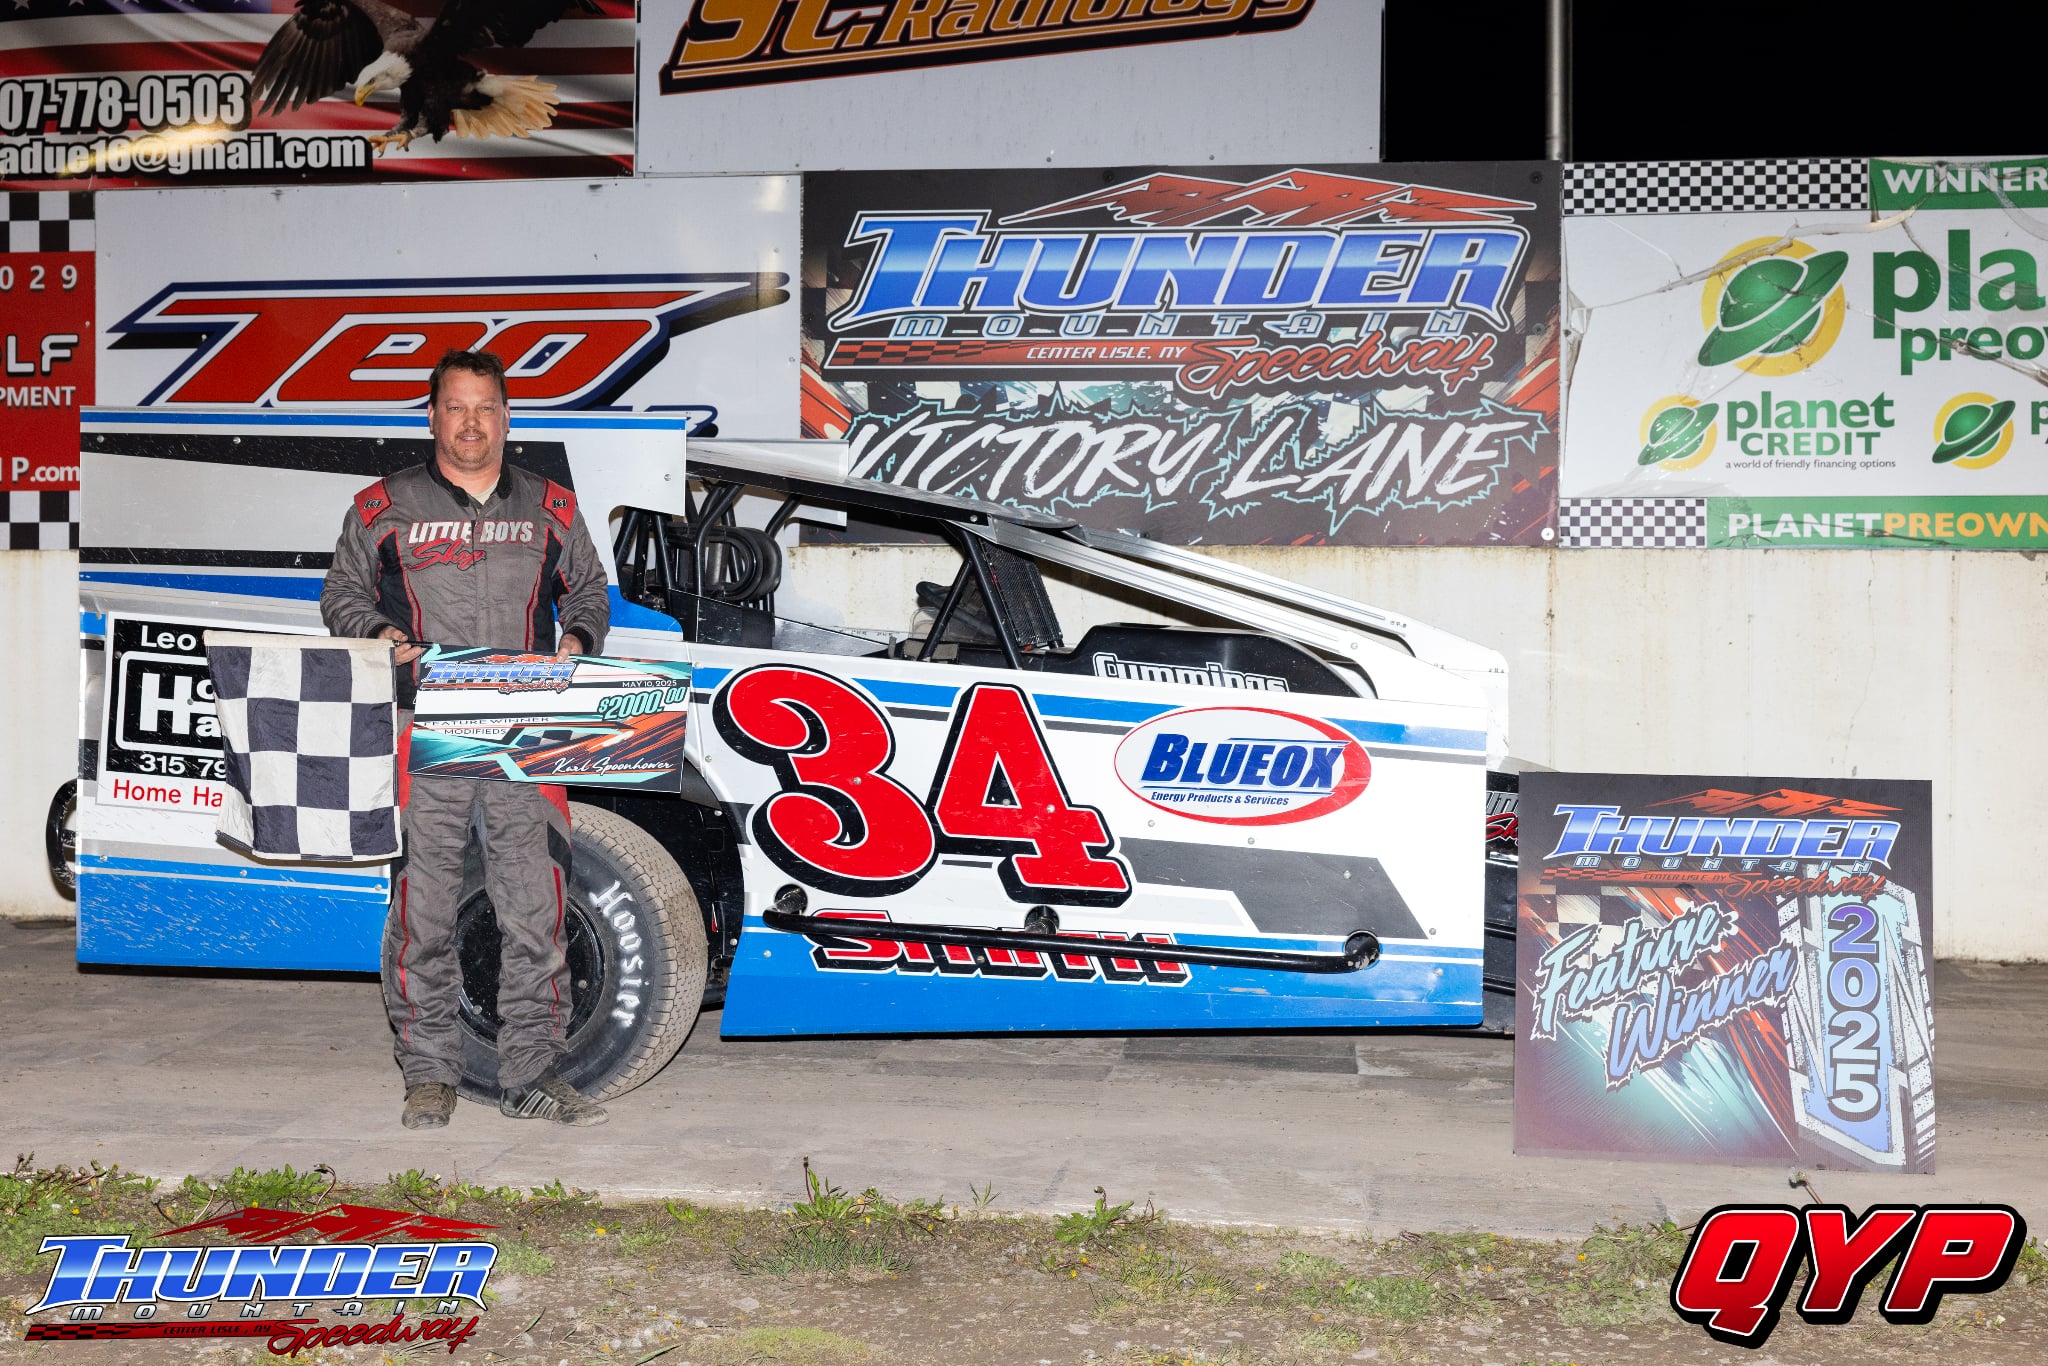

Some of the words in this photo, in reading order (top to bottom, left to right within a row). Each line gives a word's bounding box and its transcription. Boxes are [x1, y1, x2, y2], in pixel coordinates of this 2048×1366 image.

[0, 76, 245, 130] 07-778-0503
[835, 213, 1518, 328] THUNDER
[1873, 229, 2046, 339] pla
[893, 312, 1466, 338] MOUNTAIN
[1026, 346, 1097, 359] CENTER
[1098, 346, 1153, 360] LISLE,
[1158, 346, 1187, 359] NY
[1183, 335, 1492, 391] Speedway
[1901, 326, 2048, 375] preo
[1727, 391, 1895, 441] planet
[848, 418, 1221, 500] VICTORY
[1221, 416, 1531, 504] LANE
[1740, 432, 1881, 456] CREDIT
[1733, 459, 1761, 469] world
[1763, 459, 1773, 468] of
[1775, 459, 1810, 470] friendly
[1814, 459, 1856, 470] financing
[1860, 459, 1896, 469] options
[408, 521, 473, 545] LITTLE
[479, 521, 534, 544] BOYS
[141, 625, 197, 651] Leo
[421, 660, 577, 683] THUNDER
[444, 728, 506, 736] MODIFIEDS
[139, 753, 186, 774] 315
[552, 758, 592, 775] Karl
[592, 756, 674, 776] Spoonhower
[1141, 733, 1345, 789] BLUEOX
[113, 778, 182, 804] Home
[713, 665, 1132, 907] 34
[1151, 791, 1185, 803] Energy
[1187, 792, 1233, 805] Products
[1235, 795, 1241, 804] &
[1243, 795, 1289, 806] Services
[1543, 804, 1900, 868] THUNDER
[1573, 855, 1872, 874] MOUNTAIN
[1720, 870, 1886, 901] Speedway
[589, 880, 650, 1028] Hoosier
[1541, 902, 1720, 1032] Feature
[1609, 949, 1797, 1078] Winner
[1829, 903, 1880, 1115] 2025
